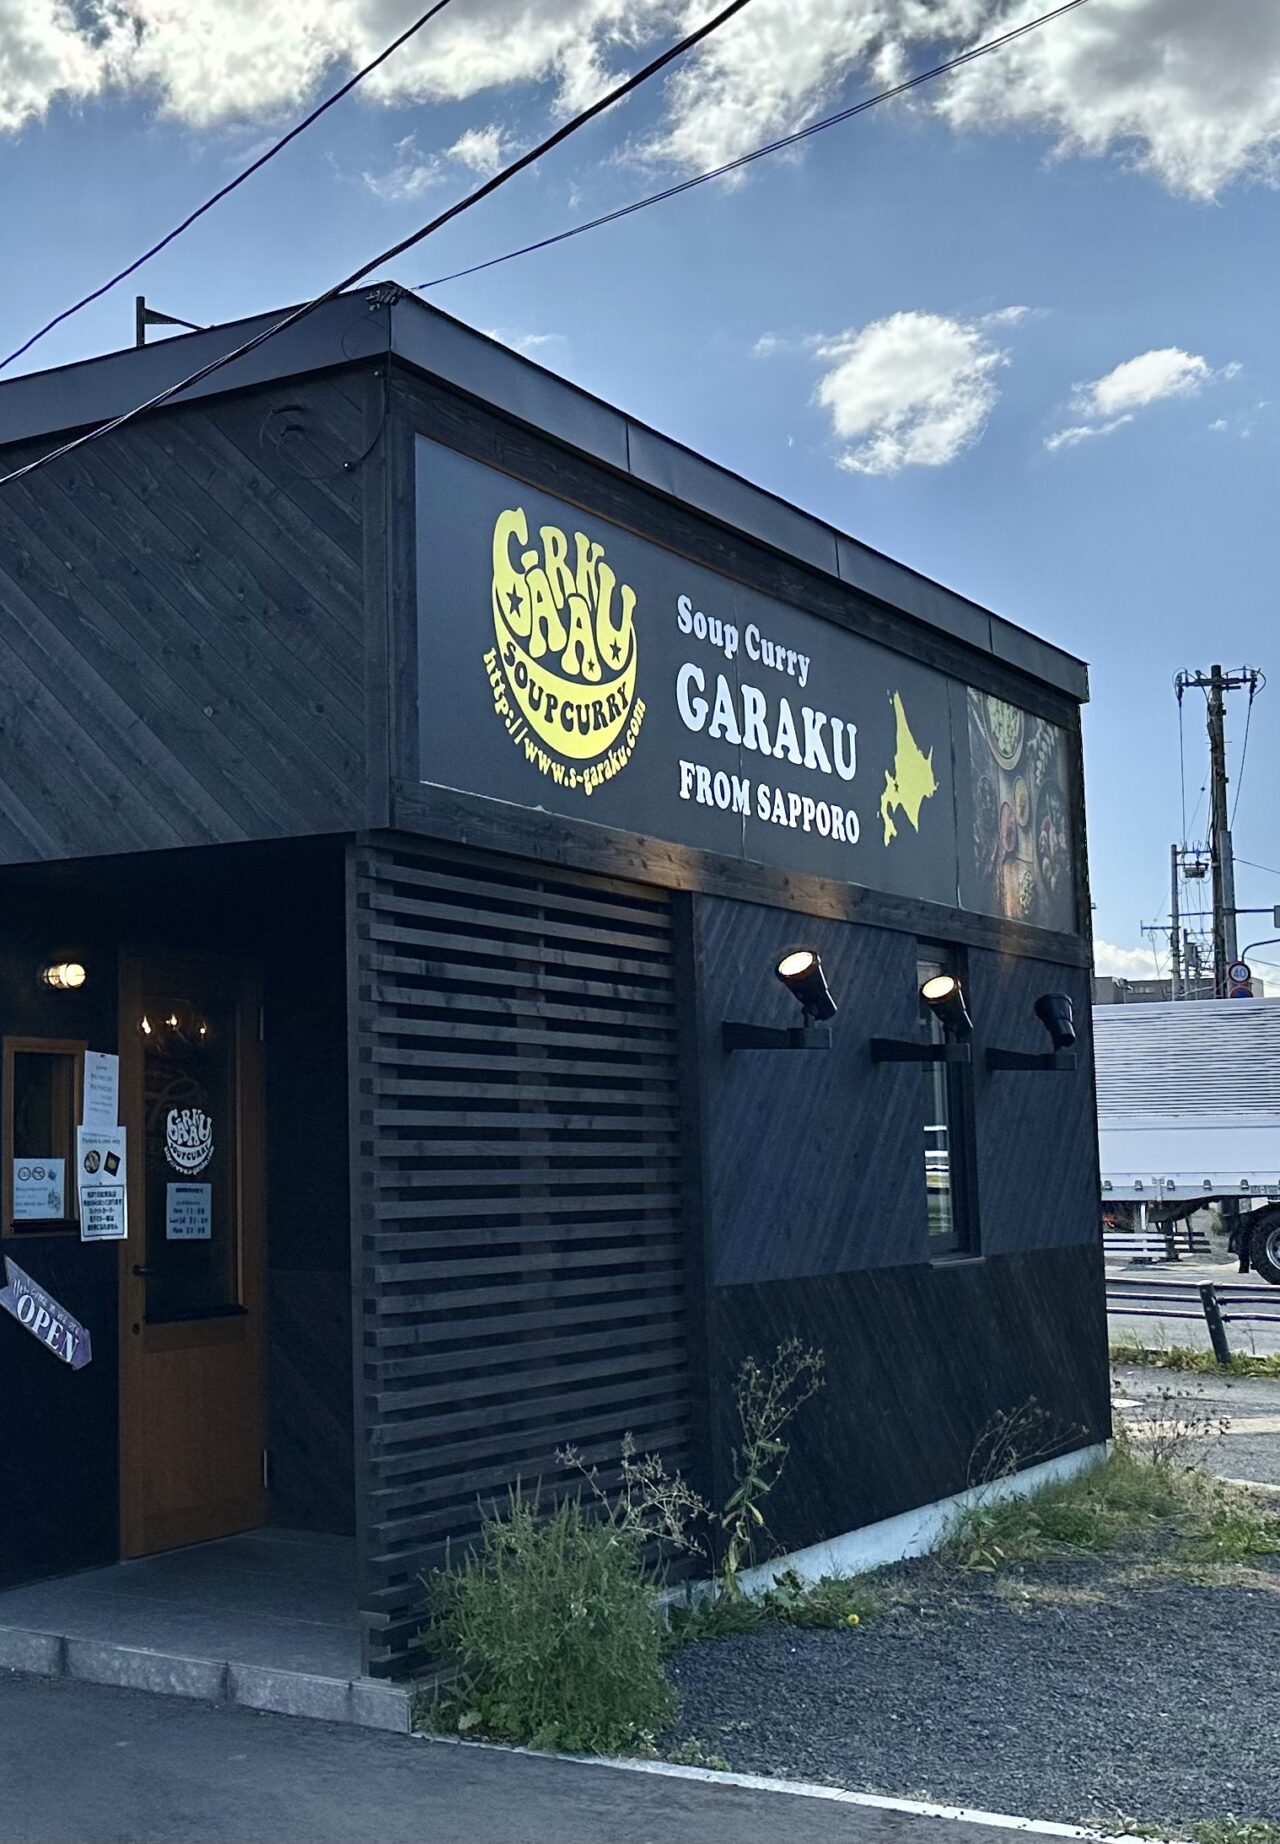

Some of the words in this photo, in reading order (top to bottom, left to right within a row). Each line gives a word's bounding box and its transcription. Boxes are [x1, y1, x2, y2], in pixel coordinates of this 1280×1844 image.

[677, 594, 739, 659] Soup
[745, 623, 811, 687] Curry
[676, 662, 858, 781] GARAKU
[678, 760, 751, 816] FROM
[757, 783, 860, 845] SAPPORO
[1233, 967, 1247, 978] 40
[17, 1294, 80, 1363] OPEN
